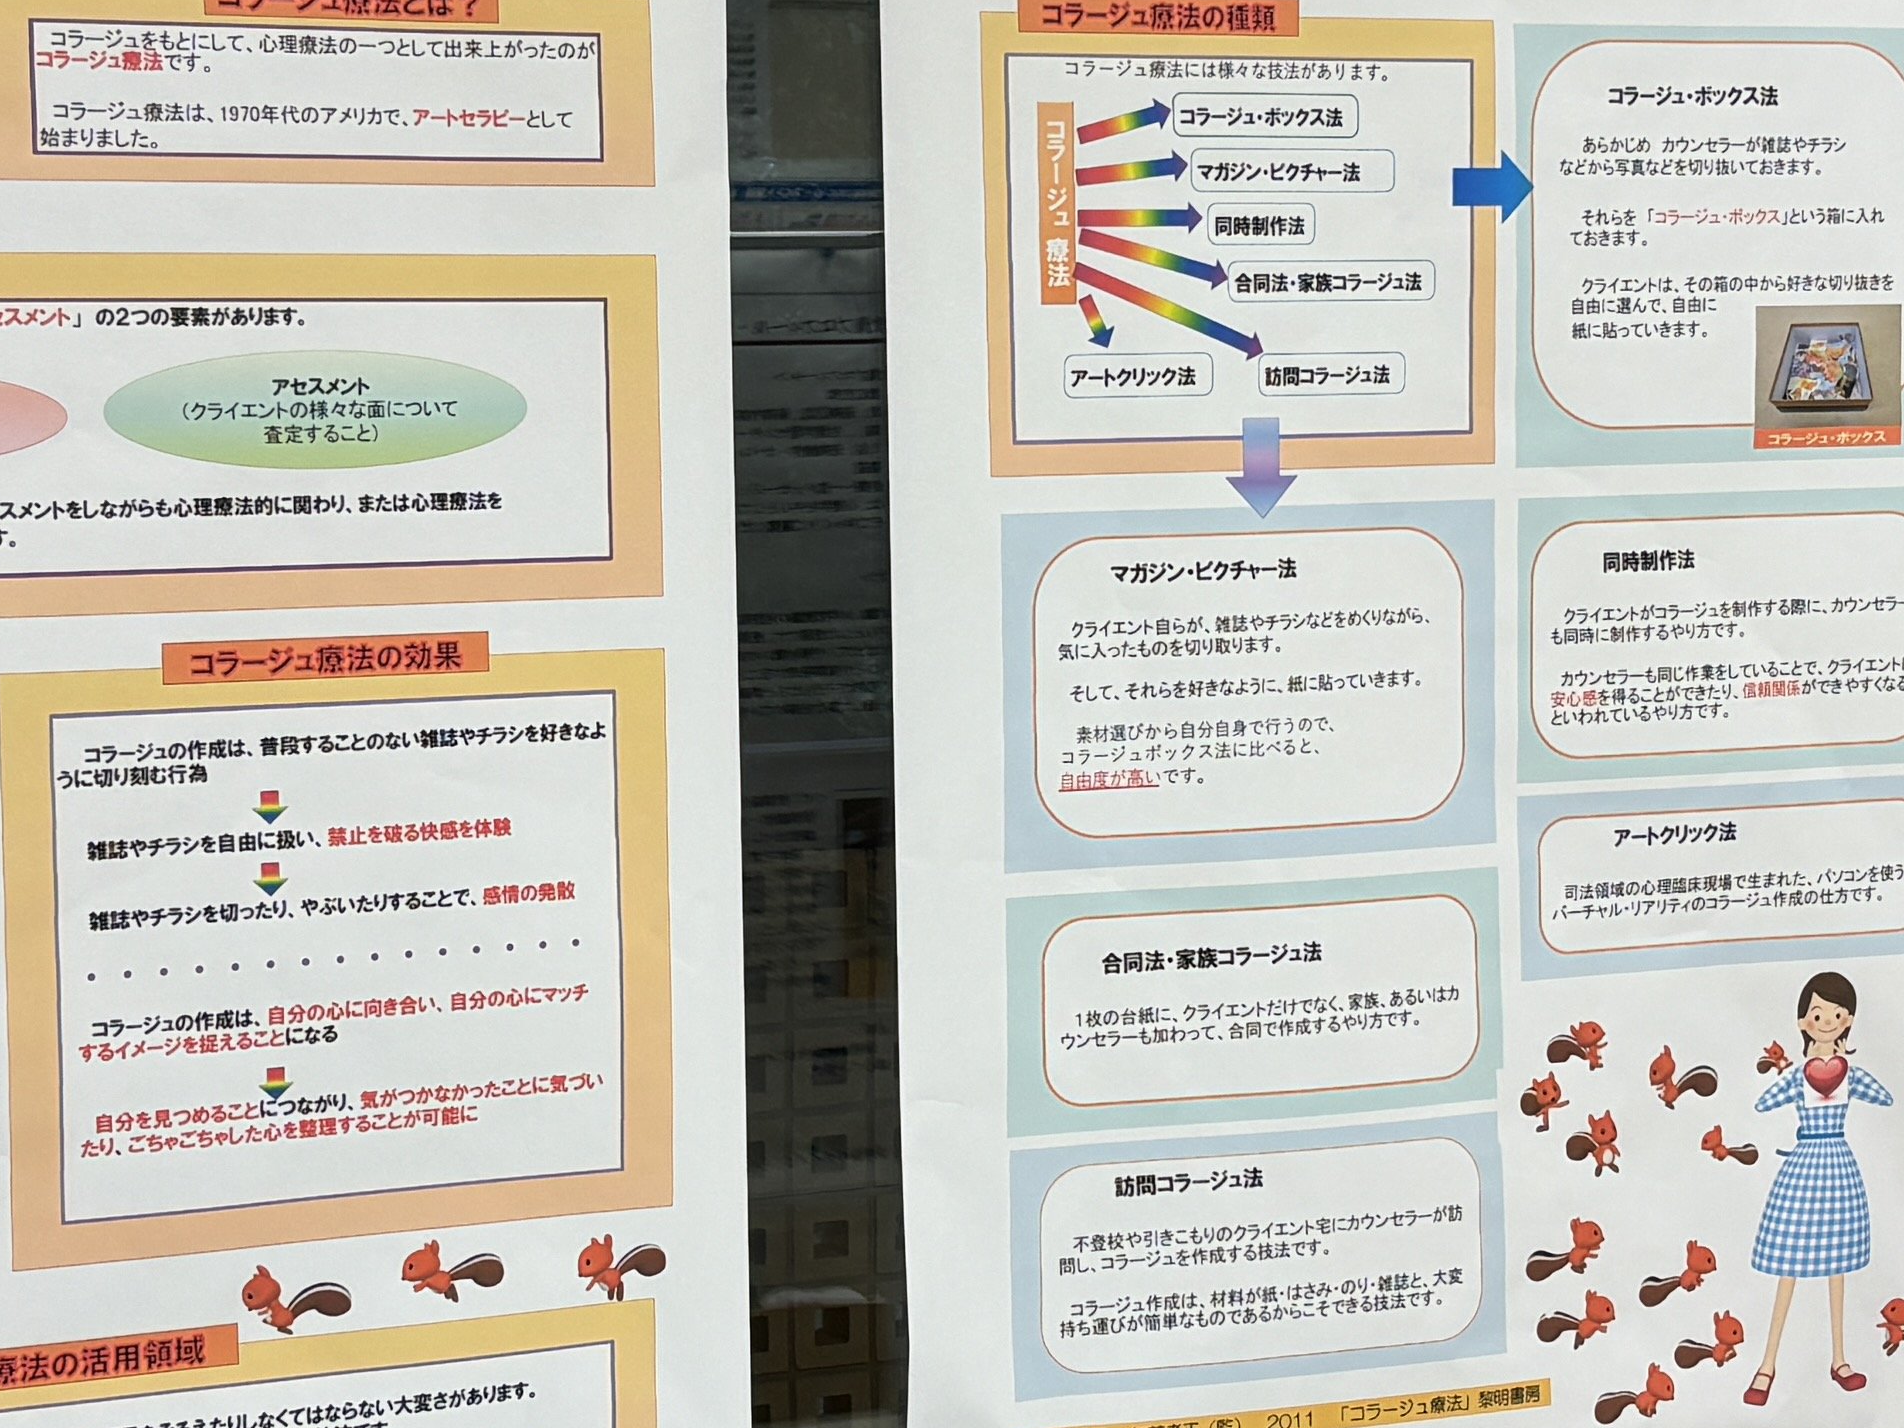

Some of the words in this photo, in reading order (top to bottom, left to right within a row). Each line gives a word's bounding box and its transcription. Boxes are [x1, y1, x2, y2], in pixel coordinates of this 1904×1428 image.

[1042, 2, 1276, 31] コラージュ療法の種類
[36, 50, 211, 73] コラージュ療法です。
[1608, 86, 1778, 106] コラージュ・ボックス法
[1180, 107, 1343, 128] コラージュ・ボックス法
[40, 126, 159, 150] 始まりました。
[1198, 162, 1361, 182] マガジン・ピクチャー法
[1559, 158, 1822, 176] などから写真などを切り抜いておきます。
[1215, 216, 1304, 237] 同時制作法
[1570, 230, 1648, 247] ておきます。
[1235, 272, 1422, 294] 合同法・家族コラージュ法
[1572, 297, 1716, 315] 自由に選んで、自由に
[1572, 320, 1708, 339] 紙に貼っていきます。
[272, 377, 370, 397] アセスメント
[1071, 366, 1196, 388] アートクリック法
[1266, 366, 1390, 387] 訪問コラージュ法
[265, 424, 380, 444] 査定すること）
[1768, 429, 1886, 446] コラージュ・ボックス
[1111, 558, 1297, 584] マガジン・ピクチャー法
[1603, 549, 1695, 573] 同時制作法
[1550, 622, 1745, 644] も同時に制作するやり方です。
[191, 641, 461, 677] コラージュ療法の効果
[1058, 635, 1281, 661] 気に入ったものを切り取ります。
[1551, 703, 1730, 726] といわれているやり方です。
[56, 765, 208, 789] うに切り刻む行為
[1060, 767, 1204, 791] 自由度が高いです。
[1614, 822, 1737, 846] アートクリック法
[1102, 941, 1322, 975] 合同法・家族コラージュ法
[79, 1025, 338, 1062] するイメージを捉えることになる
[1115, 1167, 1264, 1199] 訪問コラージュ法
